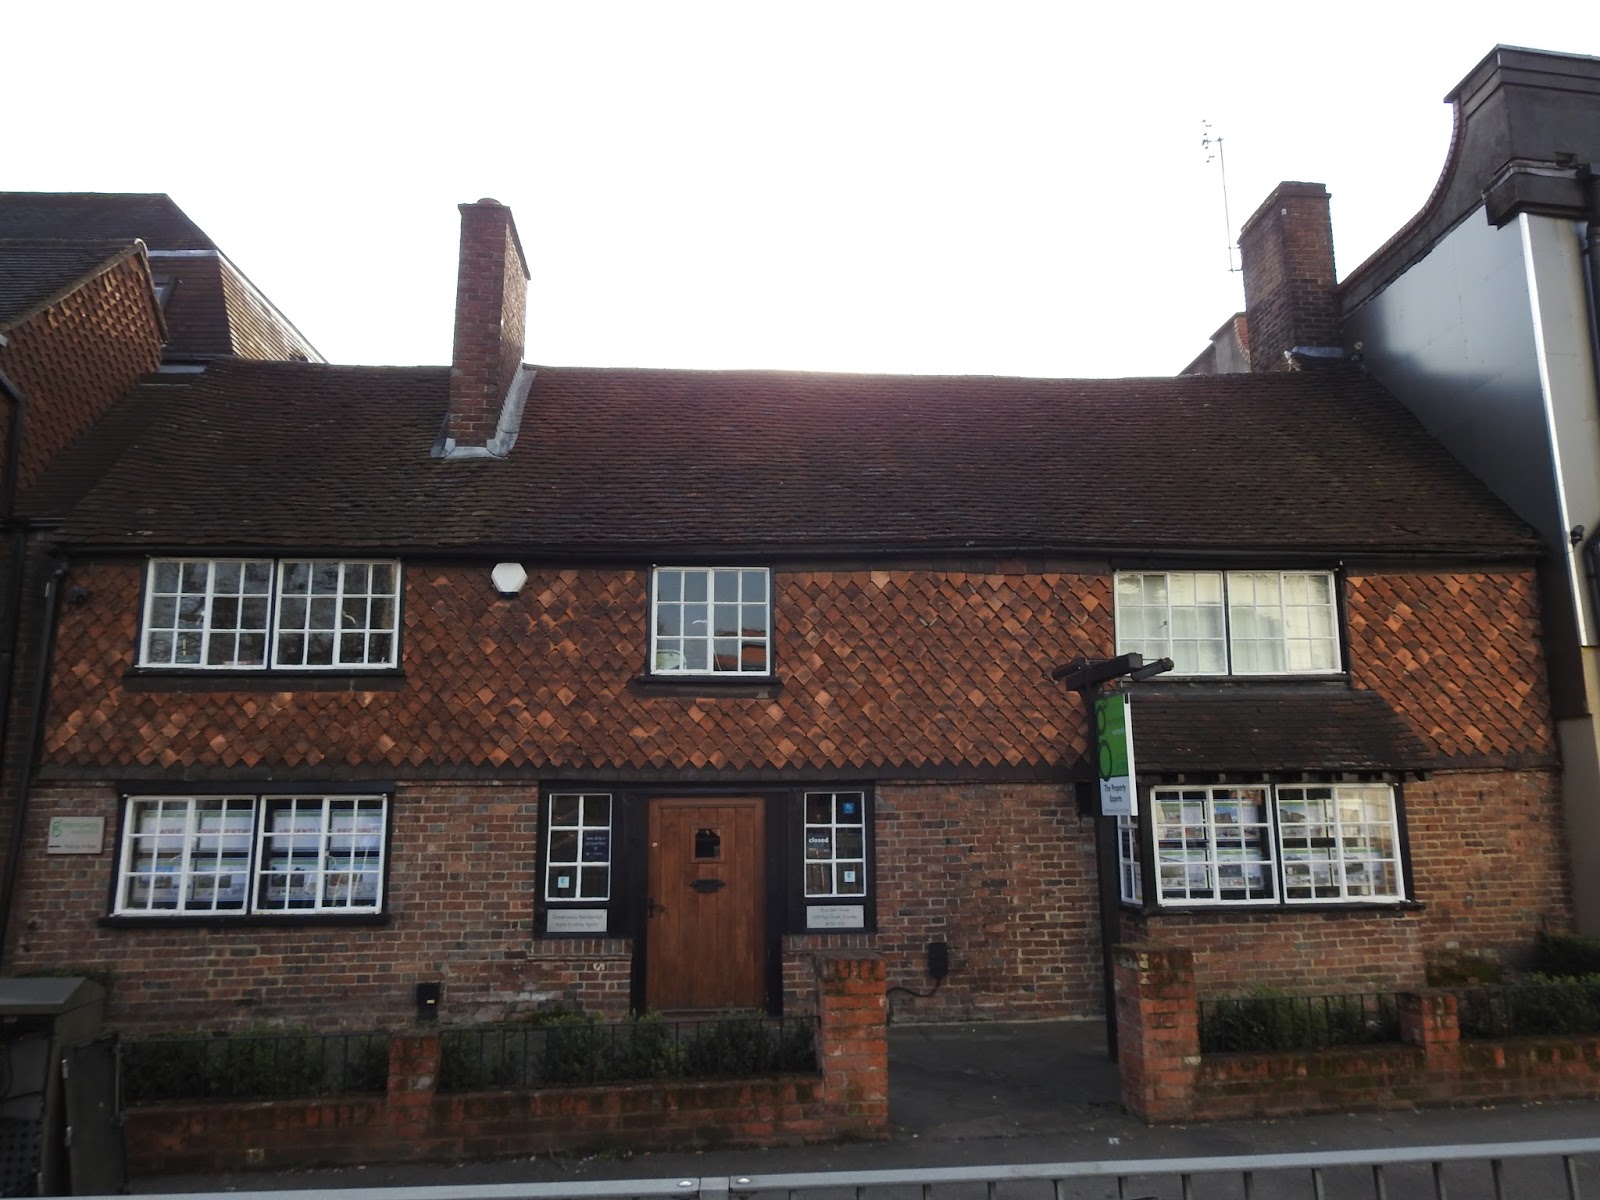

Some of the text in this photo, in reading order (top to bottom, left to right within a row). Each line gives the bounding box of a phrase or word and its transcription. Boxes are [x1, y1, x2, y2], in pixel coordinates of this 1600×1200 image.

[1111, 783, 1126, 794] Property
[1109, 793, 1123, 804] Experts
[808, 836, 829, 844] closed
